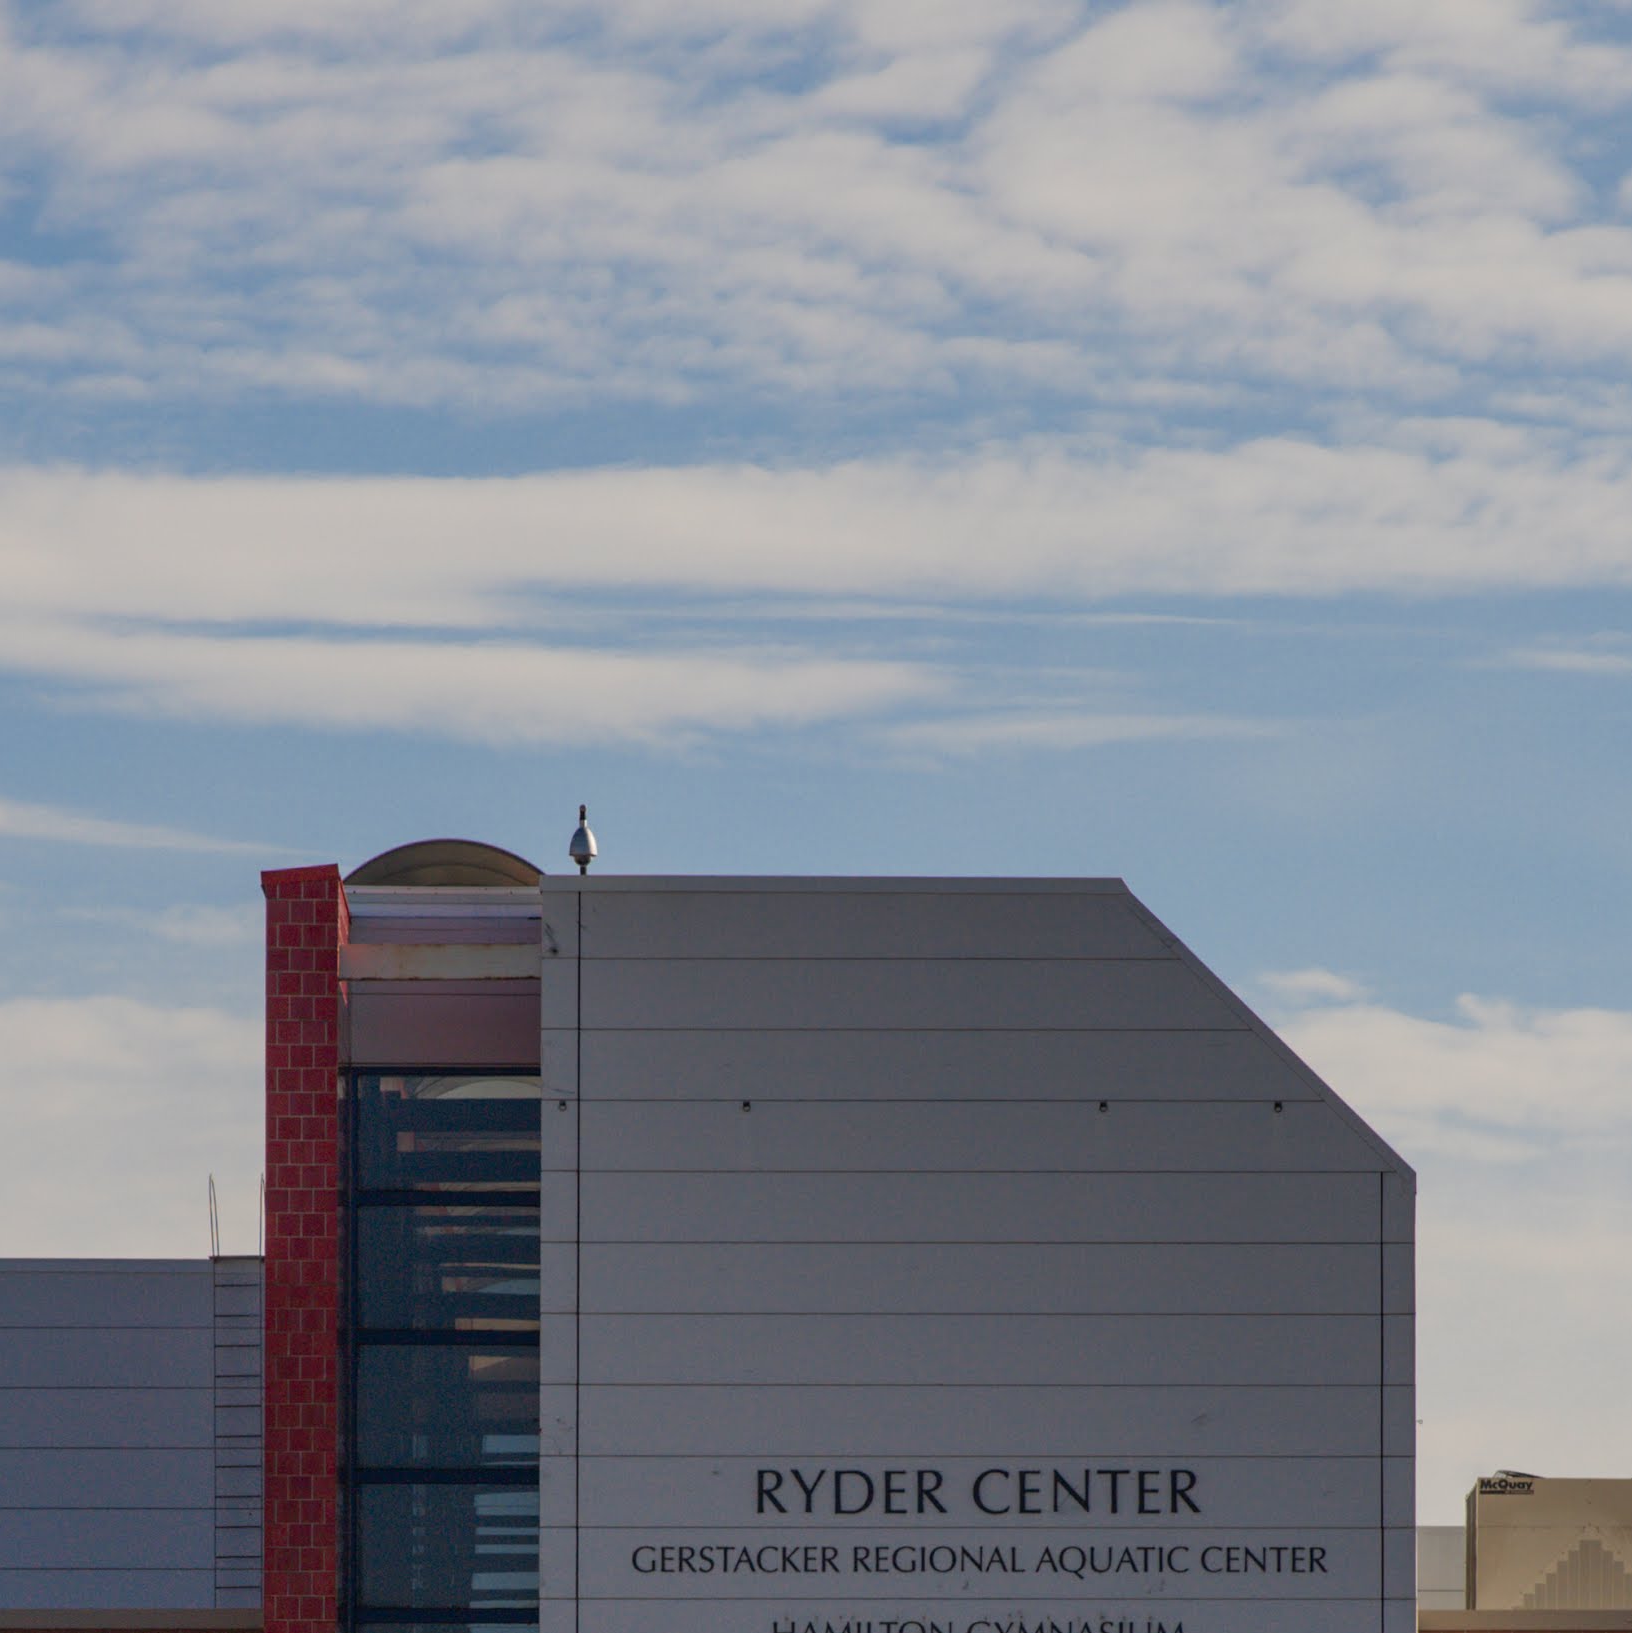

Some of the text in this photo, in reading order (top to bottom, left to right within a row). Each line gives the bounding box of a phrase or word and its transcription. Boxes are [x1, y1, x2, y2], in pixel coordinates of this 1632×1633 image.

[755, 1468, 1202, 1515] RYDER CENTER
[630, 1545, 1328, 1578] GERSTACKER REGIONAL AQUATIC CENTER
